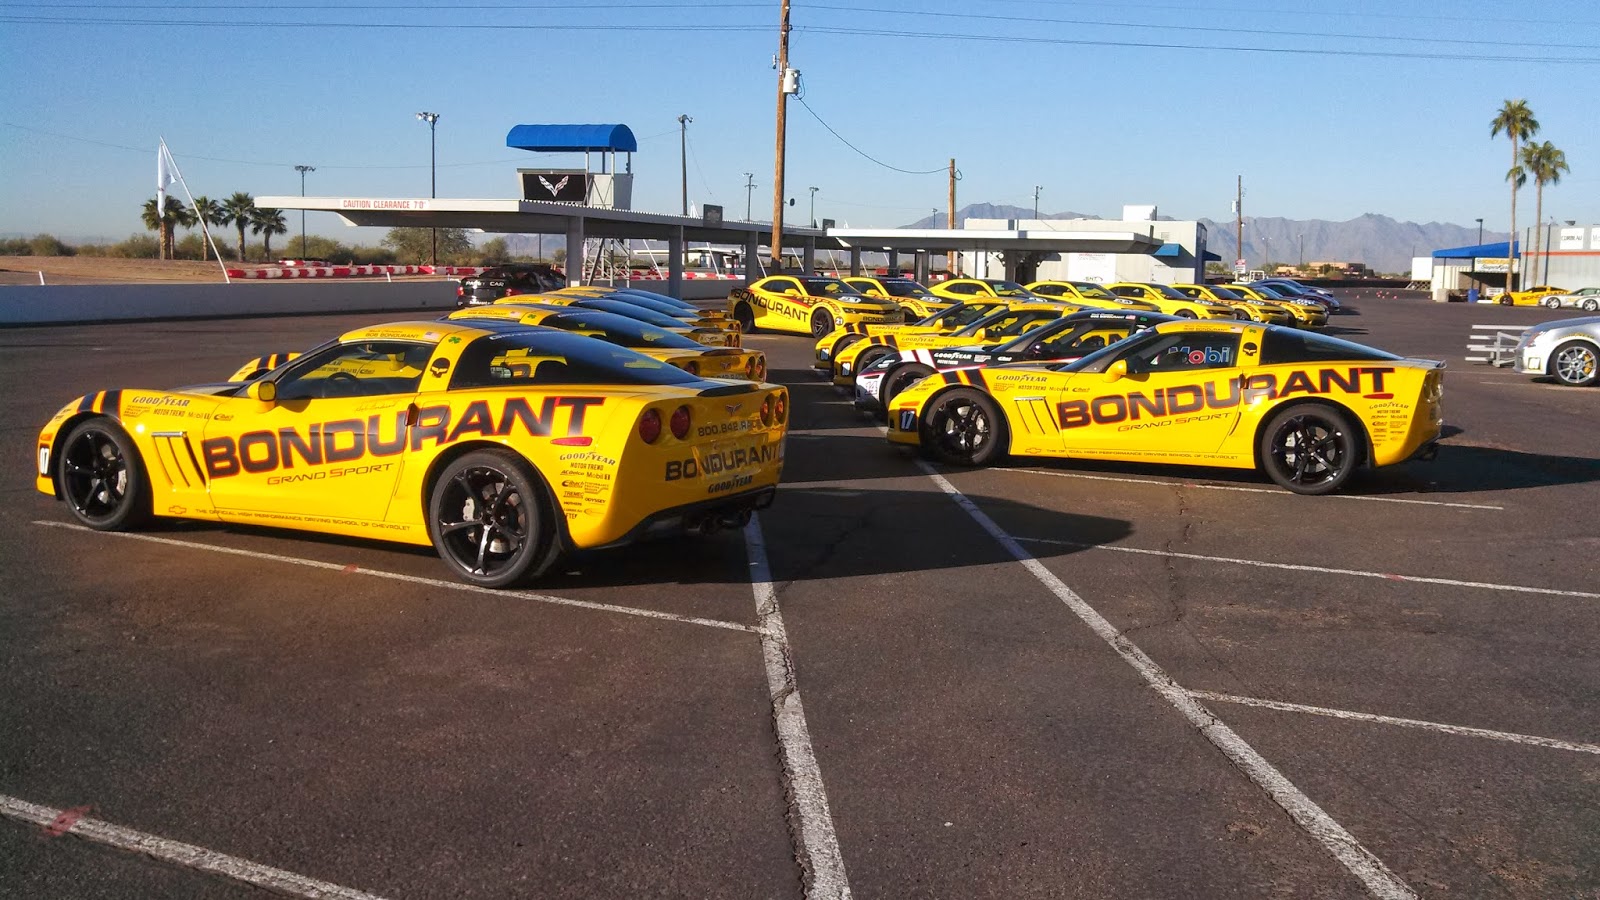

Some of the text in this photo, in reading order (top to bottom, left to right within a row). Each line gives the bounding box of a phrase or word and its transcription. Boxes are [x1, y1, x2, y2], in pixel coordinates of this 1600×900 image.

[343, 200, 371, 208] CAUTION
[373, 200, 410, 209] CLEARANCE
[731, 288, 809, 322] BONDURANT
[933, 351, 972, 359] GOODYEAR
[995, 373, 1047, 383] GOODYEAR
[132, 395, 191, 407] GOODYEAR
[1056, 367, 1395, 431] BONDURANT
[1369, 401, 1409, 410] GOODYEAR
[153, 408, 186, 417] MOTOR TREND
[901, 410, 915, 429] 17
[1117, 412, 1232, 433] GRAND SPORT
[200, 396, 607, 481] BONDURANT
[39, 447, 50, 475] 07
[560, 451, 616, 466] GOODYEAR
[266, 462, 394, 486] GRAND SPORT
[586, 471, 603, 479] Mobil
[588, 463, 604, 471] TREND
[708, 475, 753, 493] GOODYEAR
[254, 513, 302, 521] PERFORMANCE
[371, 522, 411, 531] CHEVROLET
